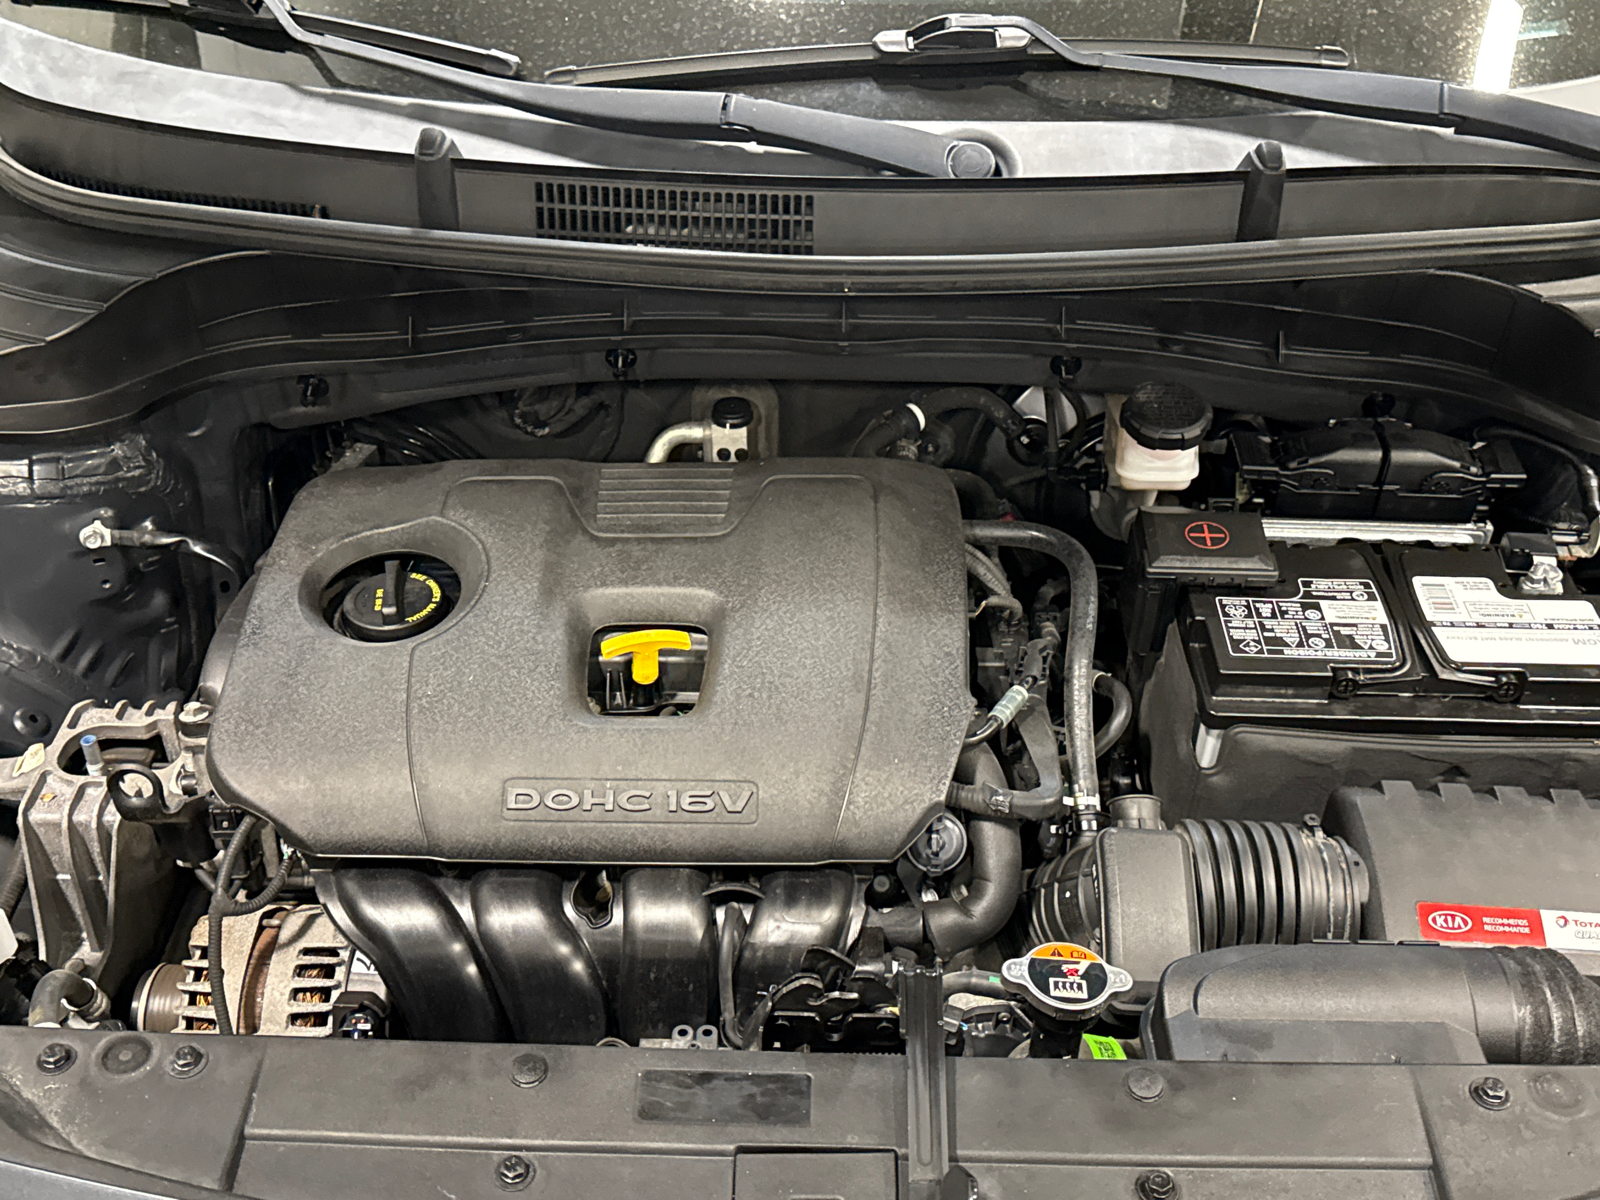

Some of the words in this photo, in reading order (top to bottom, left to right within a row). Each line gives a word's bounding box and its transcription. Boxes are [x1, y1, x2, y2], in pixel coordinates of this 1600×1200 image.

[410, 572, 428, 582] SEE
[404, 602, 437, 622] MANUAL
[506, 788, 653, 812] DOHC
[667, 790, 754, 814] 16V
[1435, 915, 1465, 929] KIA
[1482, 917, 1528, 926] RECOMMENDS
[1484, 925, 1530, 934] RECOMMANDE
